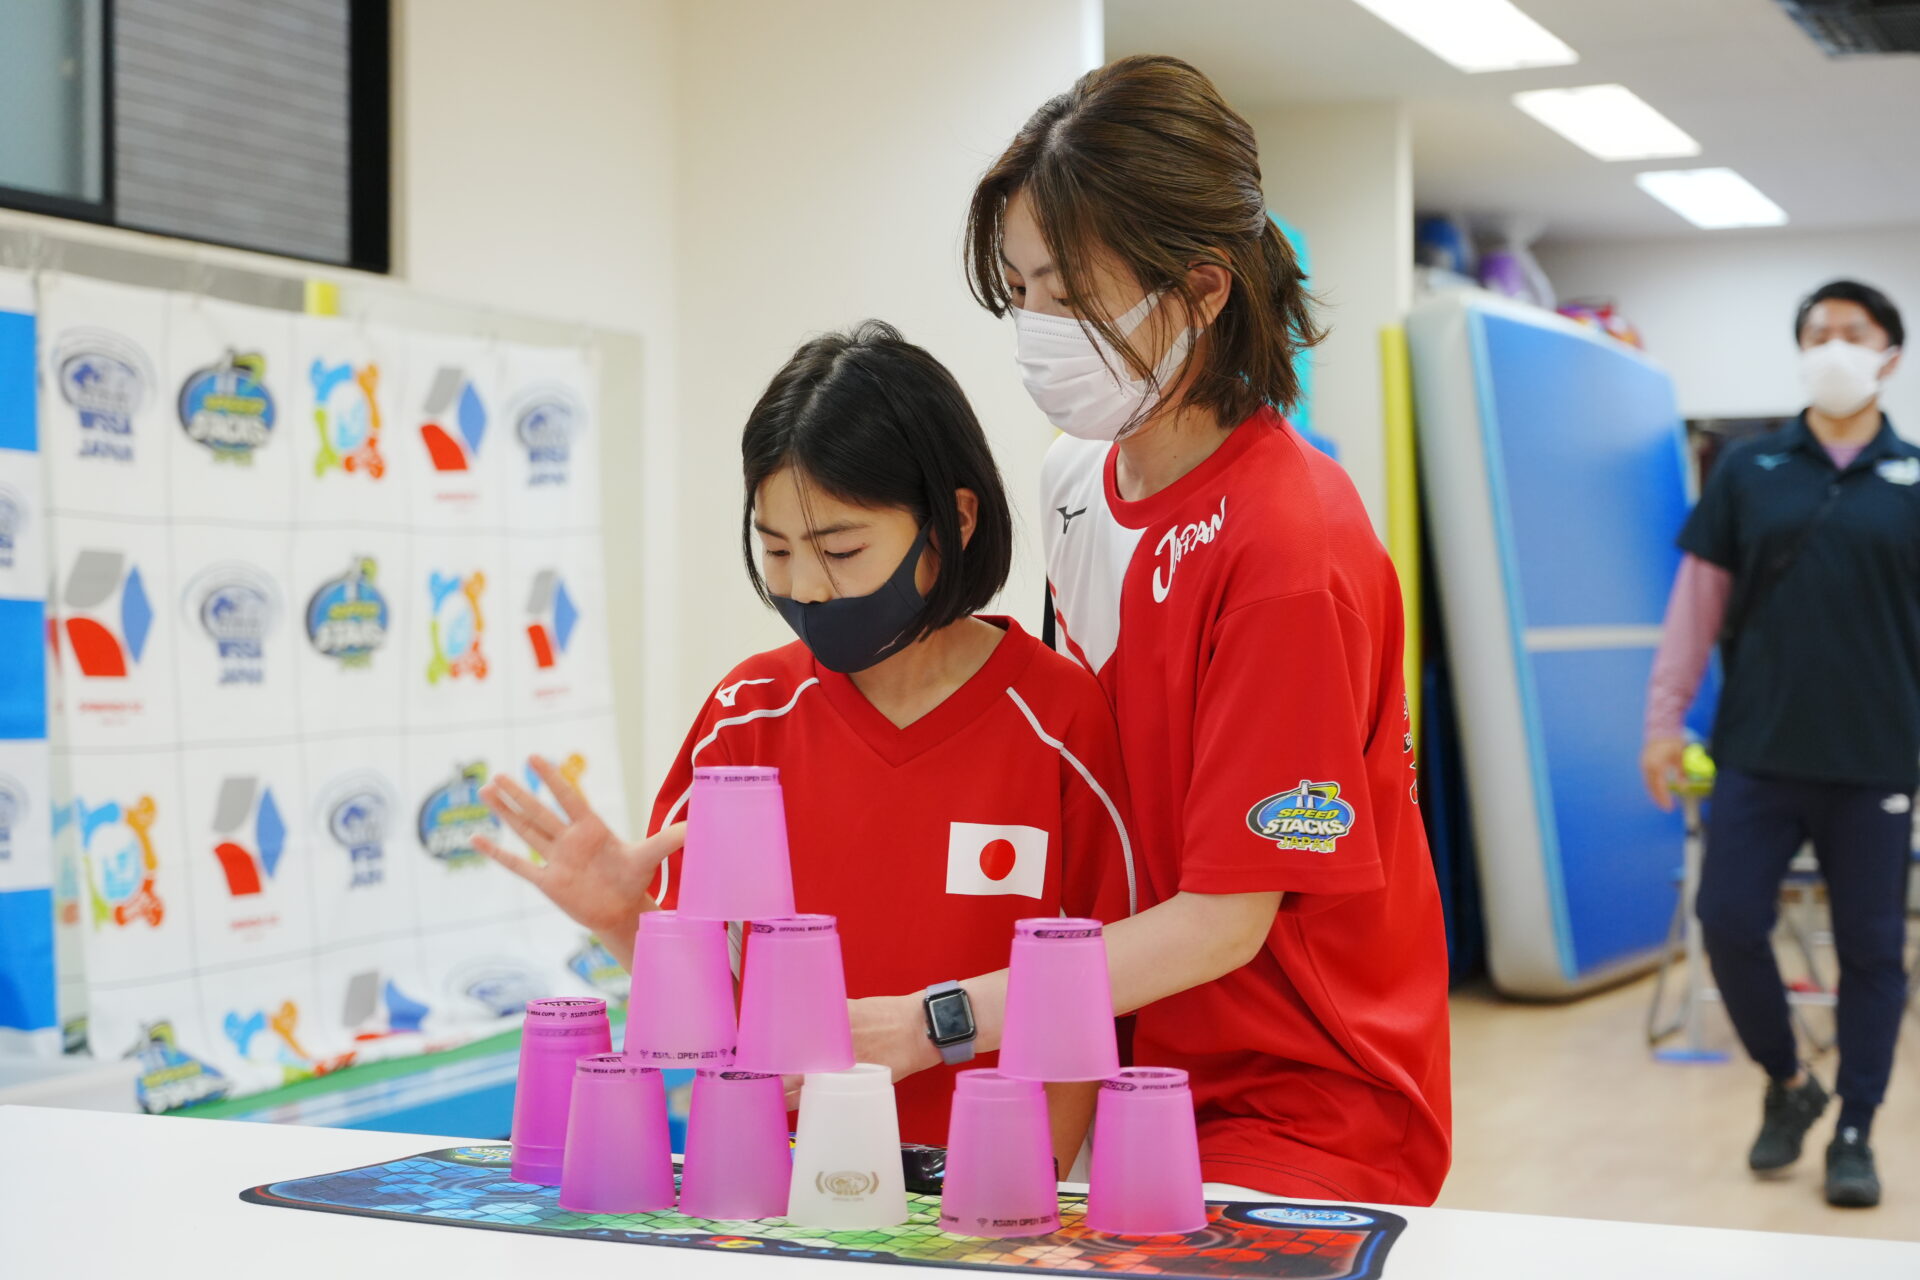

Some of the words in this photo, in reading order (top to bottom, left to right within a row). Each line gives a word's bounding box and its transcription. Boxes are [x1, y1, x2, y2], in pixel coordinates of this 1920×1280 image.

[1152, 495, 1226, 603] JAPAN
[1278, 808, 1340, 820] SPEED
[1262, 818, 1347, 836] STACKS
[1278, 835, 1335, 852] JAPAN
[1019, 1218, 1039, 1226] OPEN
